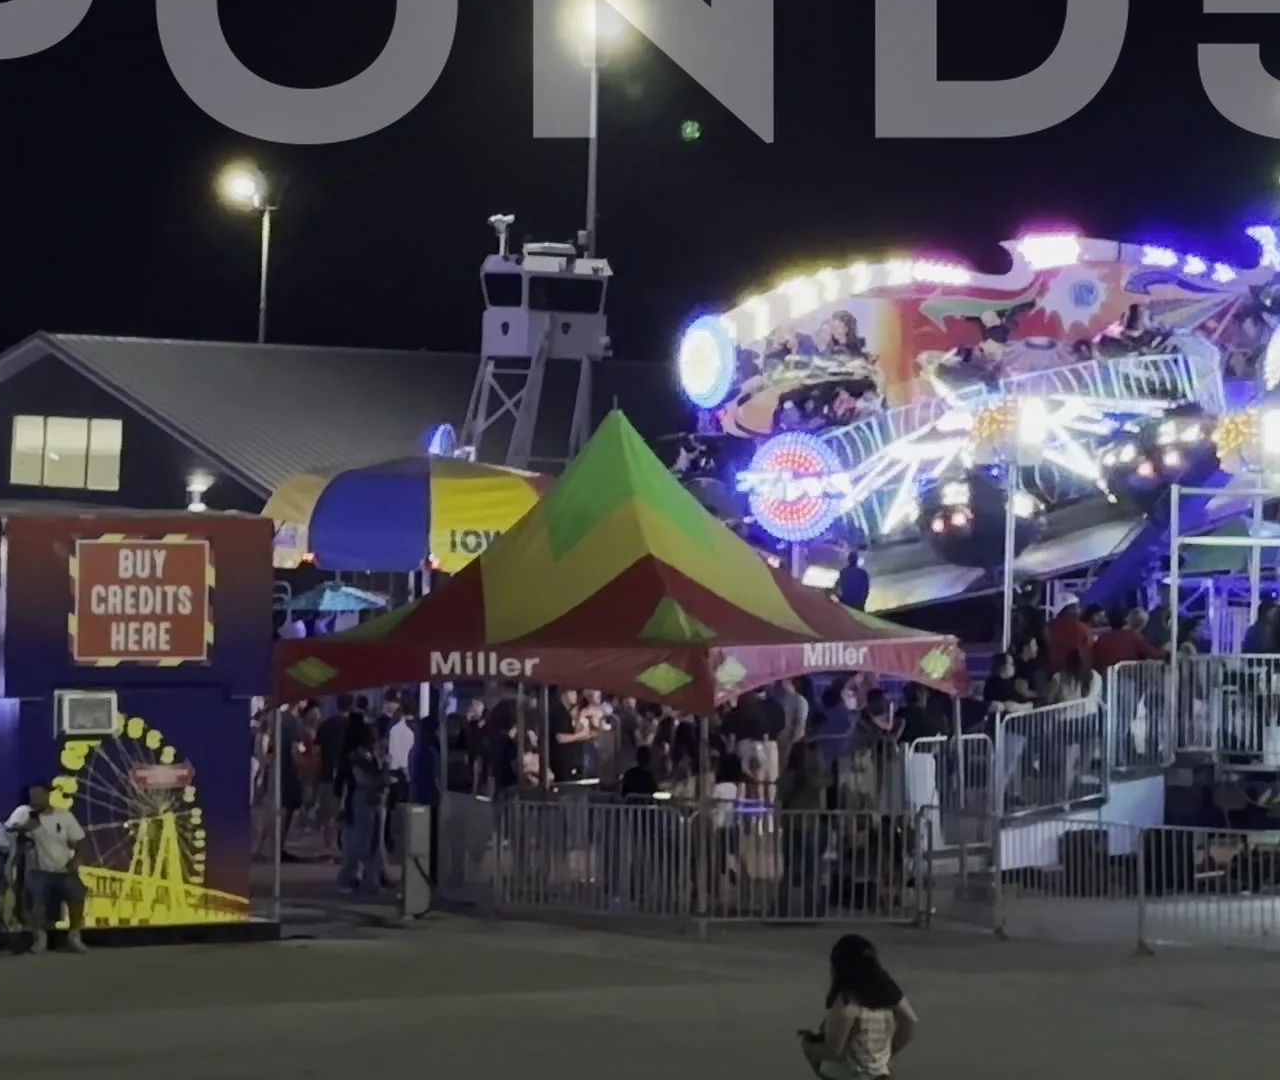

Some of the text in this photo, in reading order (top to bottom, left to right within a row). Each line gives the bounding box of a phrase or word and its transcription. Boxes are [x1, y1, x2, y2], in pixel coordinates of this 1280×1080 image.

[118, 548, 167, 579] BUY
[90, 584, 193, 615] CREDITS
[110, 621, 173, 651] HERE
[429, 650, 540, 678] Miller
[802, 641, 869, 667] Miller
